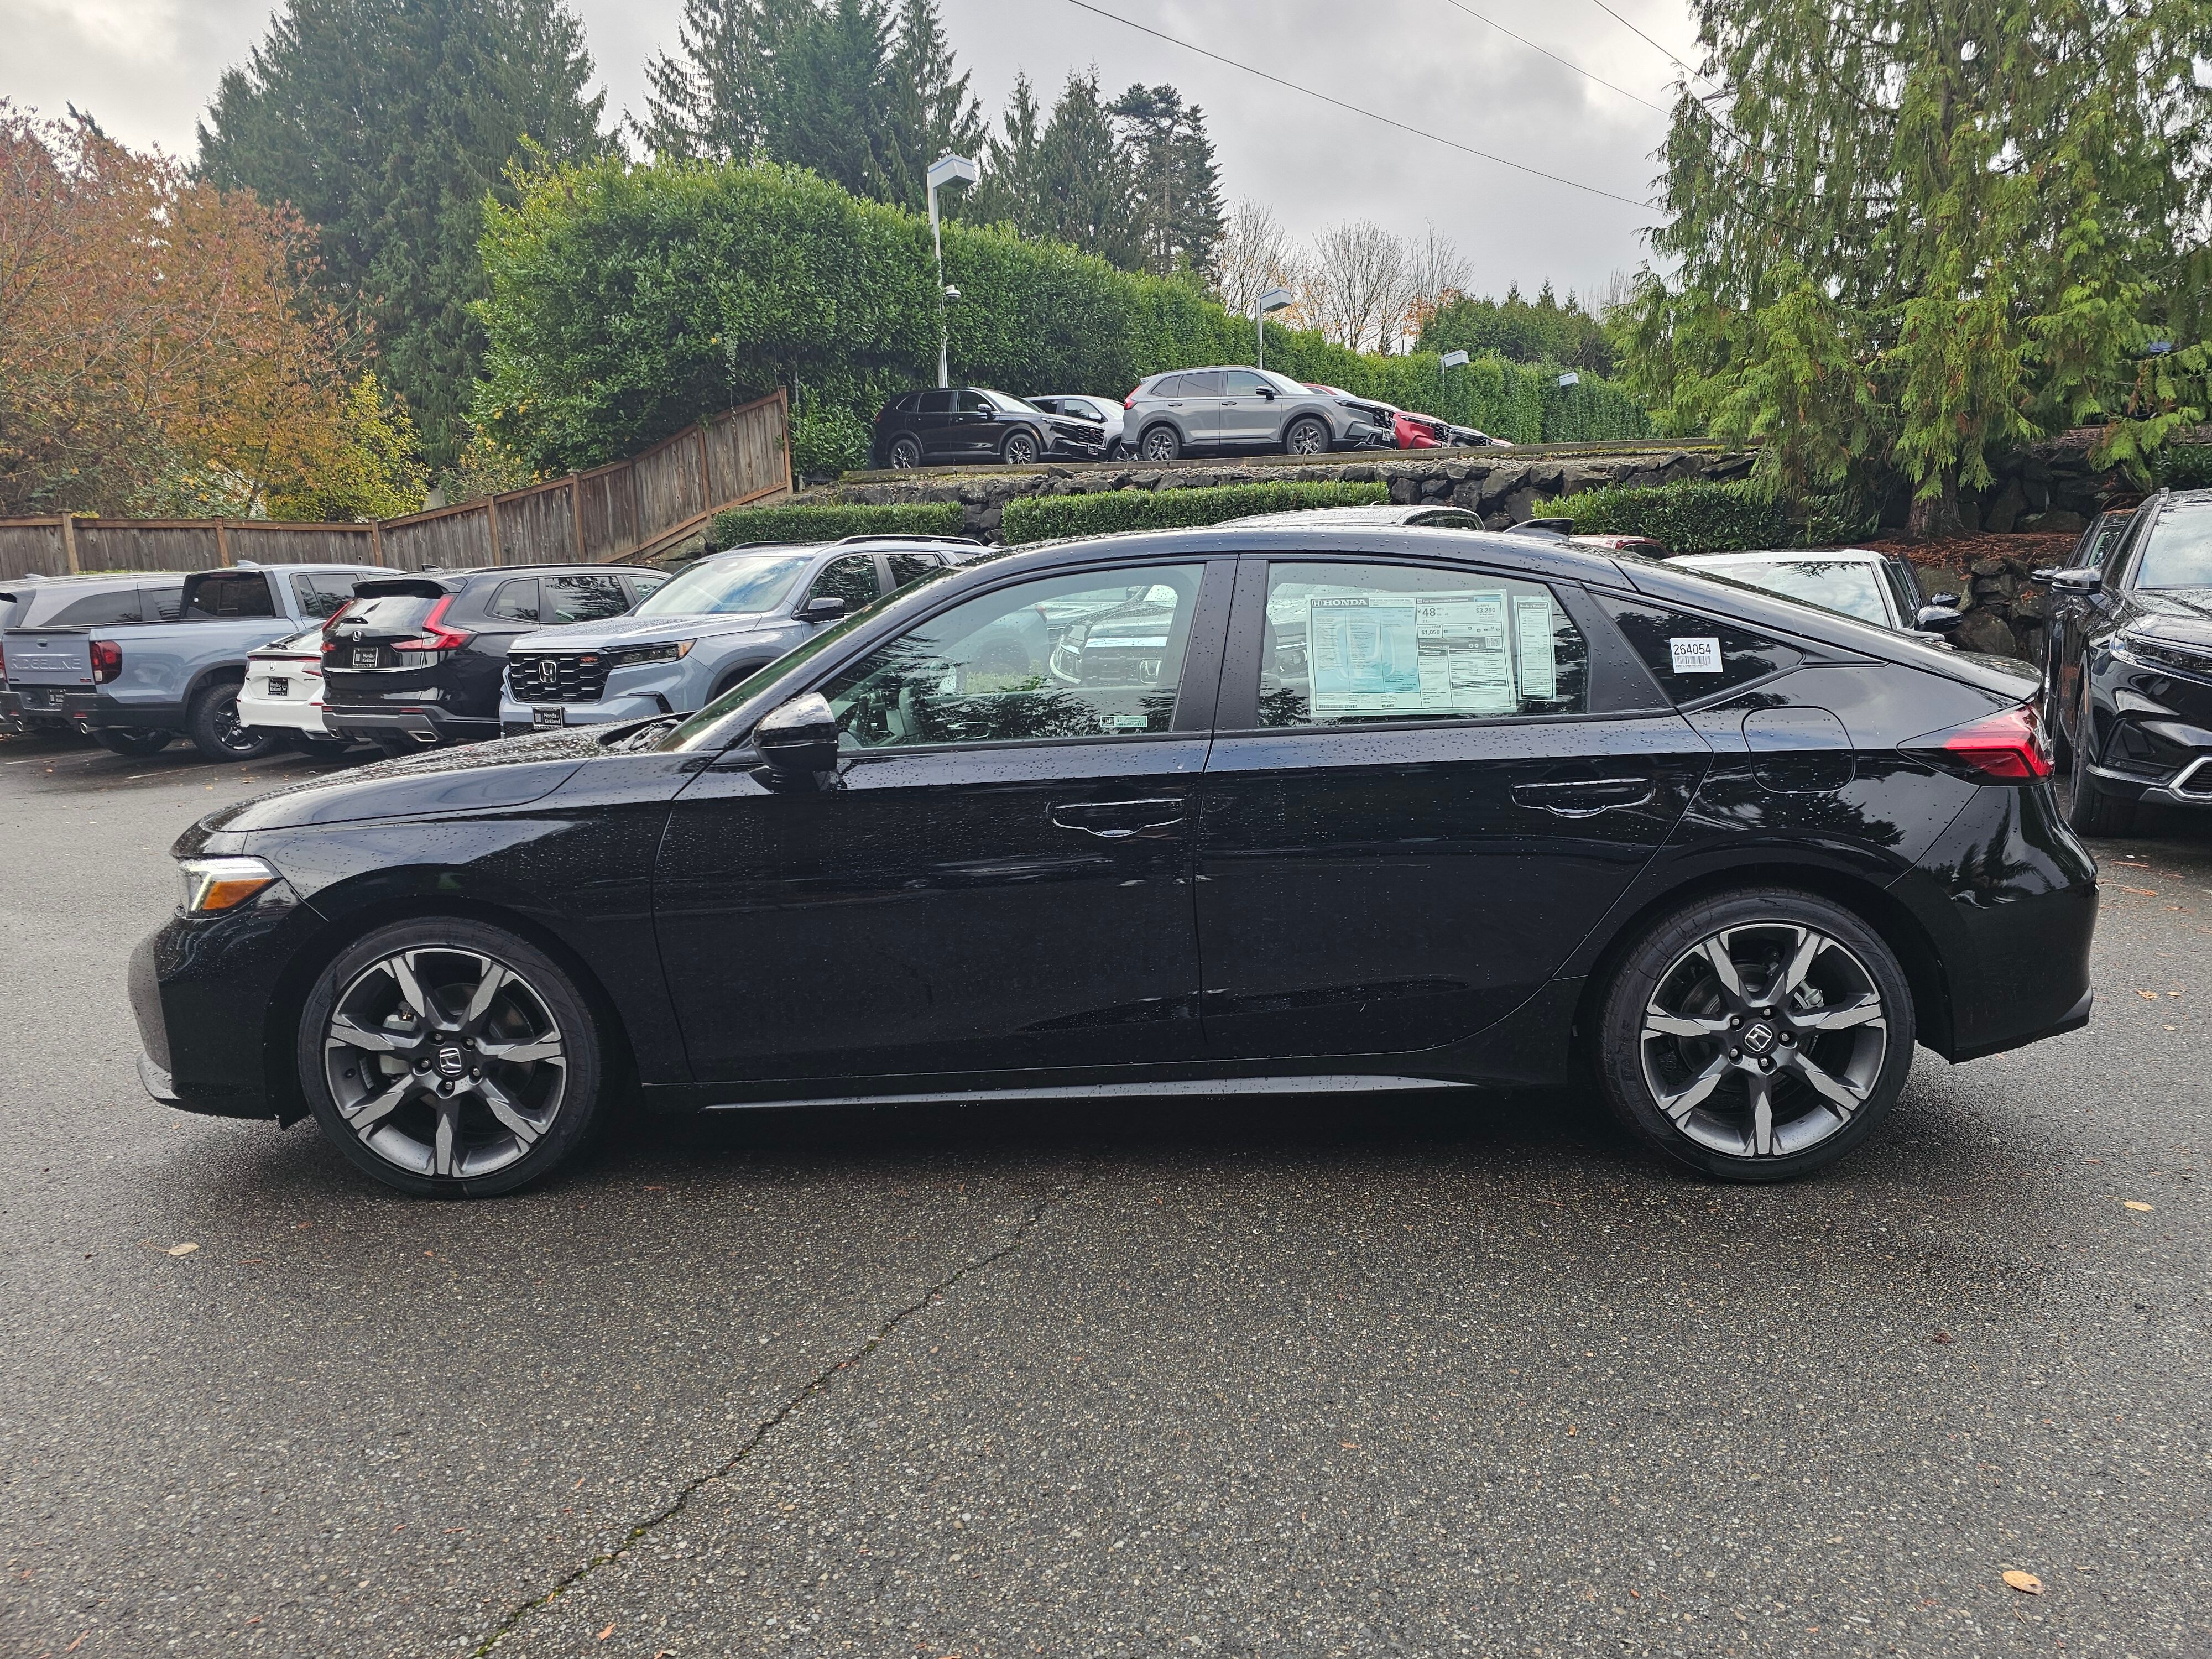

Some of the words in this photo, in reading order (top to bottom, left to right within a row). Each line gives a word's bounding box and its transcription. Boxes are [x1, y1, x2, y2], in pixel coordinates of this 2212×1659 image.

[1422, 608, 1436, 617] 48
[1673, 644, 1711, 655] 264054
[10, 656, 82, 670] RIDGELINE
